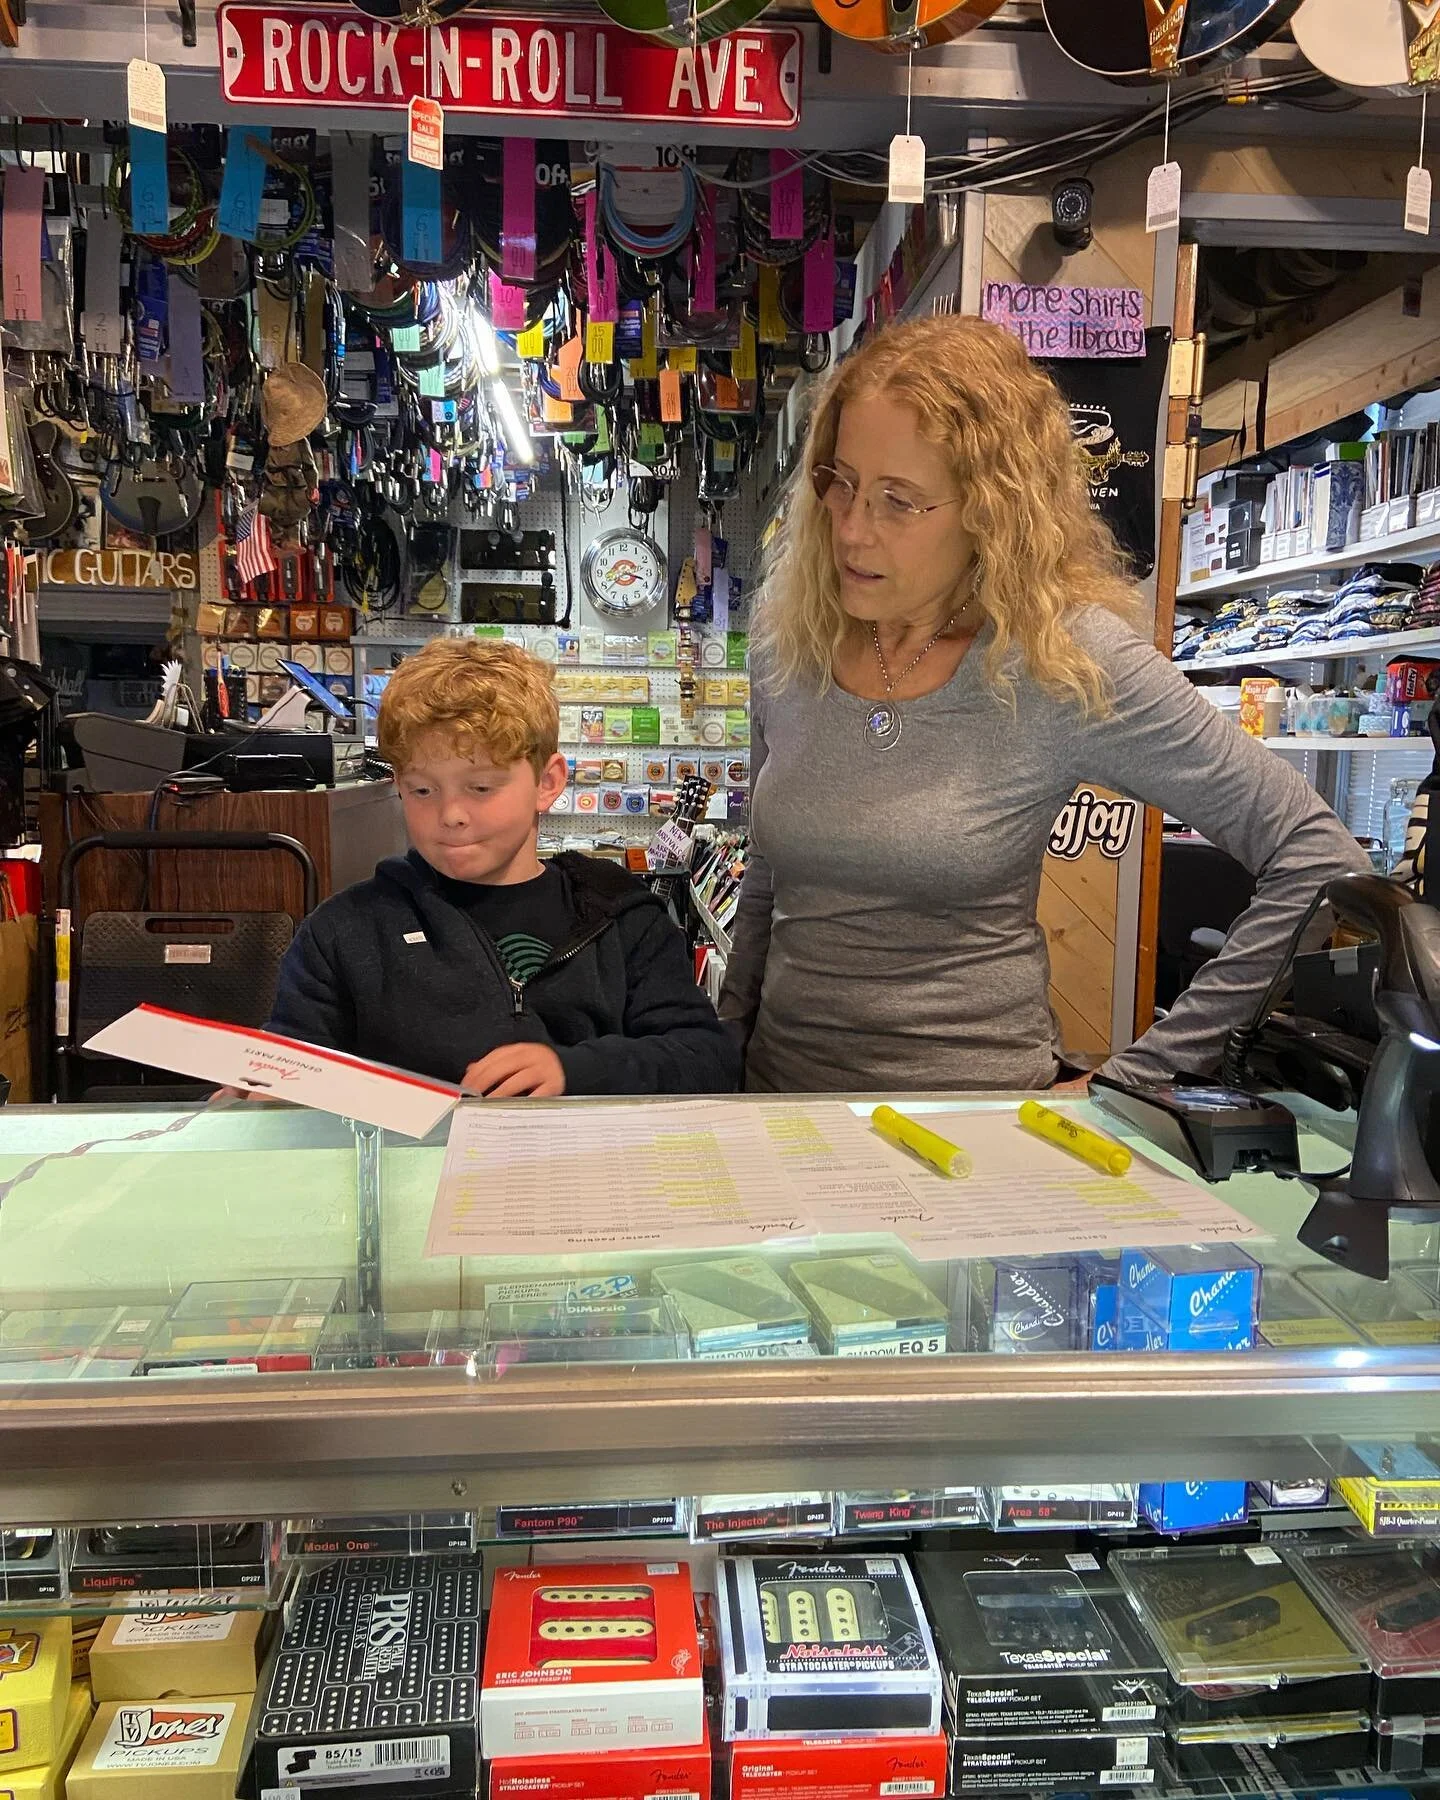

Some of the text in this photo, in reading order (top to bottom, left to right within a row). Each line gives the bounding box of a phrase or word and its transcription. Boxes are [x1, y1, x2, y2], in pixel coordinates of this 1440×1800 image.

[262, 17, 763, 112] ROCK-N-ROLL AVE
[416, 122, 435, 135] SALE
[986, 283, 1062, 313] more
[1018, 321, 1144, 355] the library
[75, 549, 196, 588] GUITARS
[1406, 667, 1418, 697] Hefty
[1052, 795, 1133, 853] gjoy
[669, 825, 686, 842] NEW
[249, 1060, 300, 1081] Fender
[276, 1057, 323, 1073] GENUINE
[880, 1212, 934, 1223] Fender
[749, 1220, 806, 1233] Fender
[1200, 1225, 1253, 1236] Fender
[568, 1304, 627, 1314] DiMarzio
[899, 1342, 924, 1354] EQ
[927, 1339, 939, 1352] 5
[854, 1509, 884, 1520] Twang
[1008, 1507, 1033, 1517] Area
[514, 1518, 555, 1528] Fantom
[705, 1520, 726, 1530] The
[304, 1541, 340, 1552] Model
[504, 1569, 541, 1581] Fender
[777, 1560, 846, 1577] Fender
[353, 1594, 373, 1650] GUITARS
[369, 1591, 413, 1647] PRS
[129, 1622, 221, 1633] PICKUPS
[377, 1646, 393, 1673] REED
[391, 1641, 405, 1671] PAUL
[780, 1645, 888, 1660] Noiseless
[363, 1646, 380, 1681] SMITH
[496, 1668, 572, 1679] ERIC JOHNSON
[115, 1708, 221, 1748] Jones
[110, 1747, 209, 1757] PICKUPS
[325, 1748, 362, 1759] 85/15
[742, 1765, 774, 1774] Original
[886, 1756, 927, 1770] Fender
[650, 1768, 691, 1783] Fender
